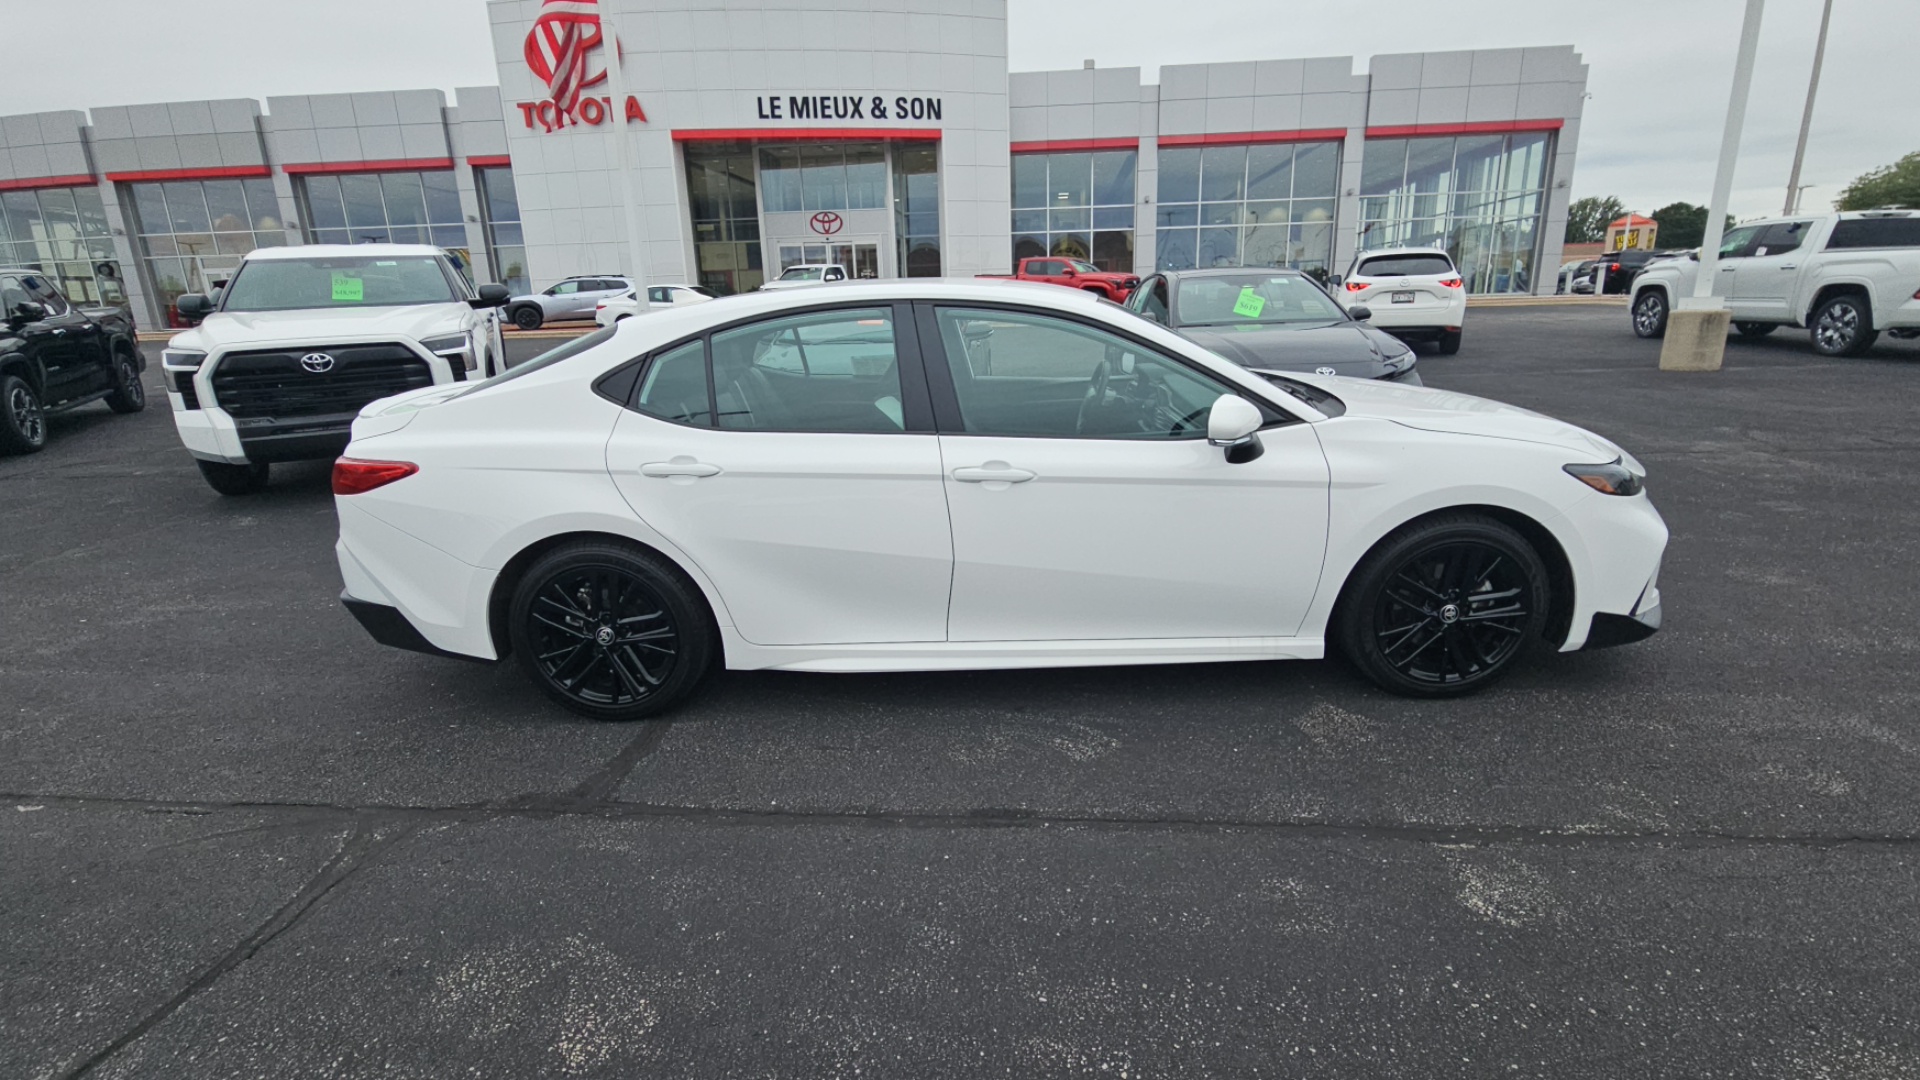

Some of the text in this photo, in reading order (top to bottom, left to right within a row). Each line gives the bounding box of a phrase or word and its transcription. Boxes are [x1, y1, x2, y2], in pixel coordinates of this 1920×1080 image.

[517, 95, 648, 130] TOOA
[757, 96, 943, 121] LE MIEUX & SON
